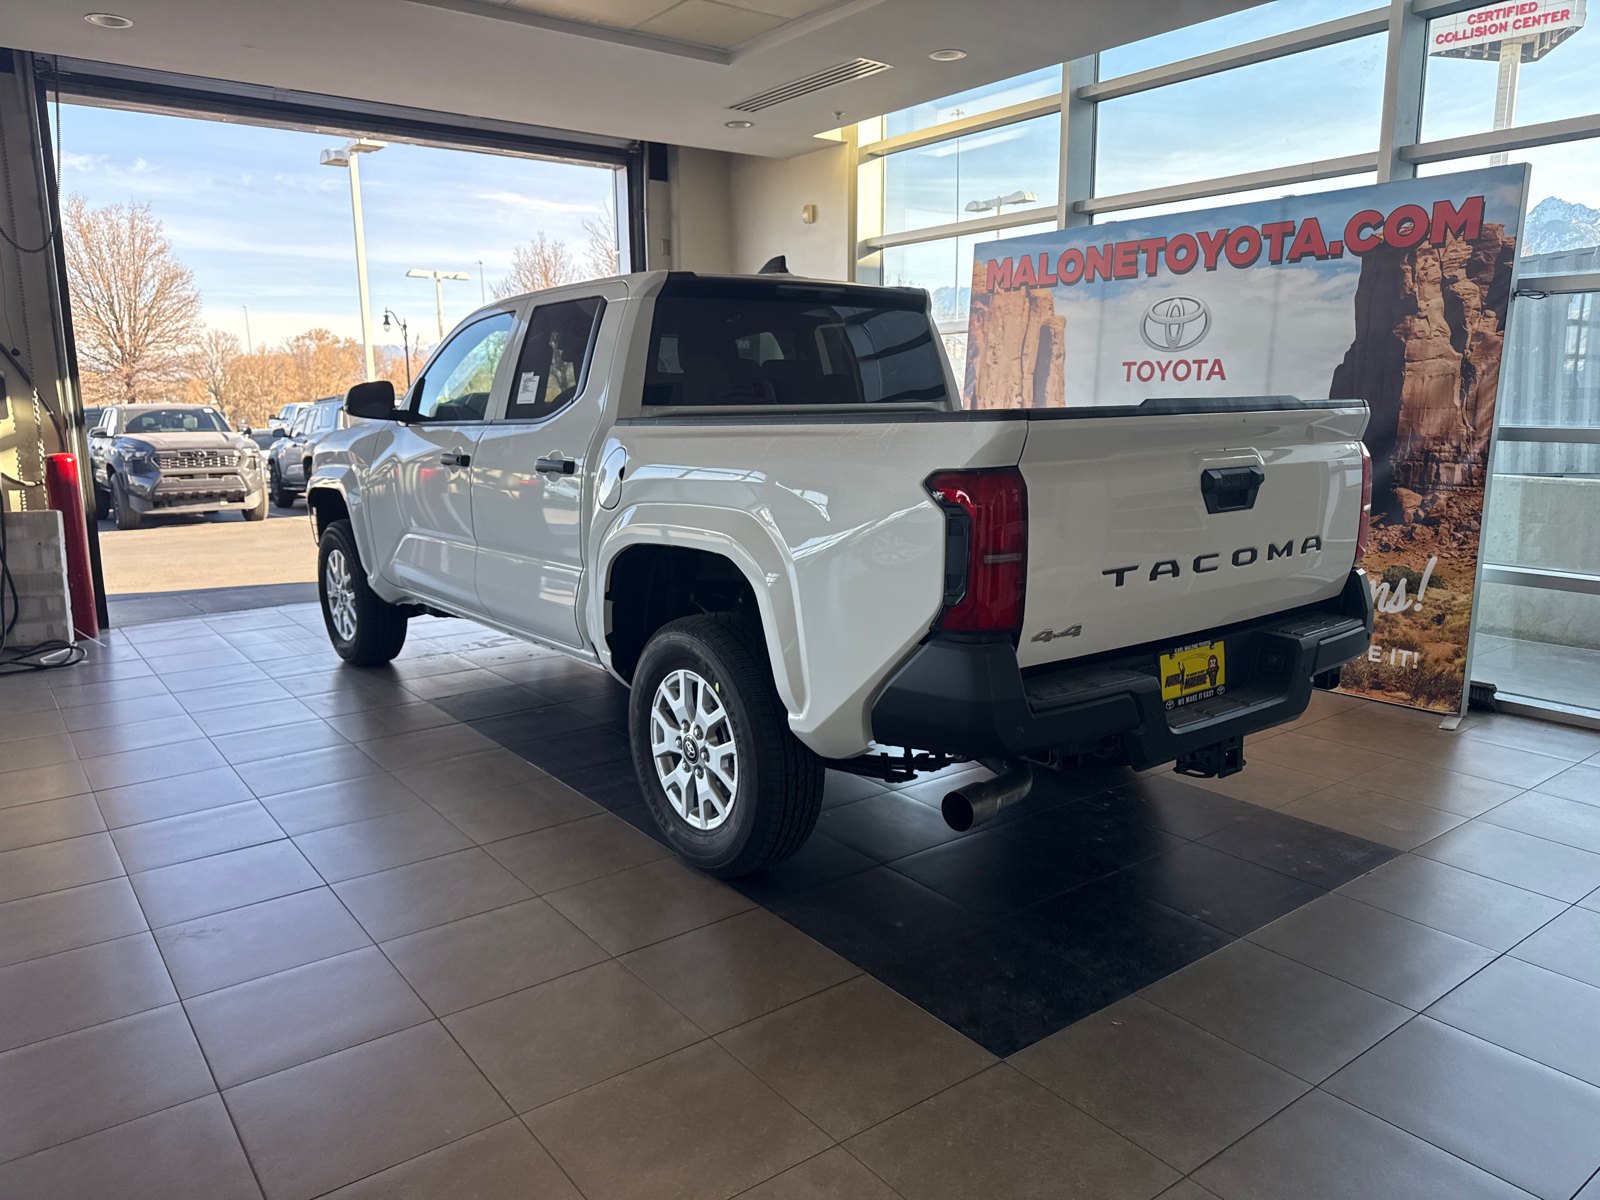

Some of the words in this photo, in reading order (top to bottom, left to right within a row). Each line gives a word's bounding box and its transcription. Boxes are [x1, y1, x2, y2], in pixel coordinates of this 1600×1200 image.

[1467, 2, 1538, 25] CERTIFIED
[1435, 21, 1508, 45] COLLISION
[1512, 9, 1570, 30] CENTER
[986, 196, 1485, 292] MALONETOYOTA.COM
[1122, 358, 1226, 383] TOYOTA
[1102, 535, 1322, 587] TACOMA
[1209, 659, 1216, 667] 32
[1390, 648, 1420, 669] IT!
[1178, 698, 1185, 706] WE
[1186, 695, 1198, 704] MAKE
[1198, 692, 1203, 700] IT
[1203, 690, 1214, 698] EASY
